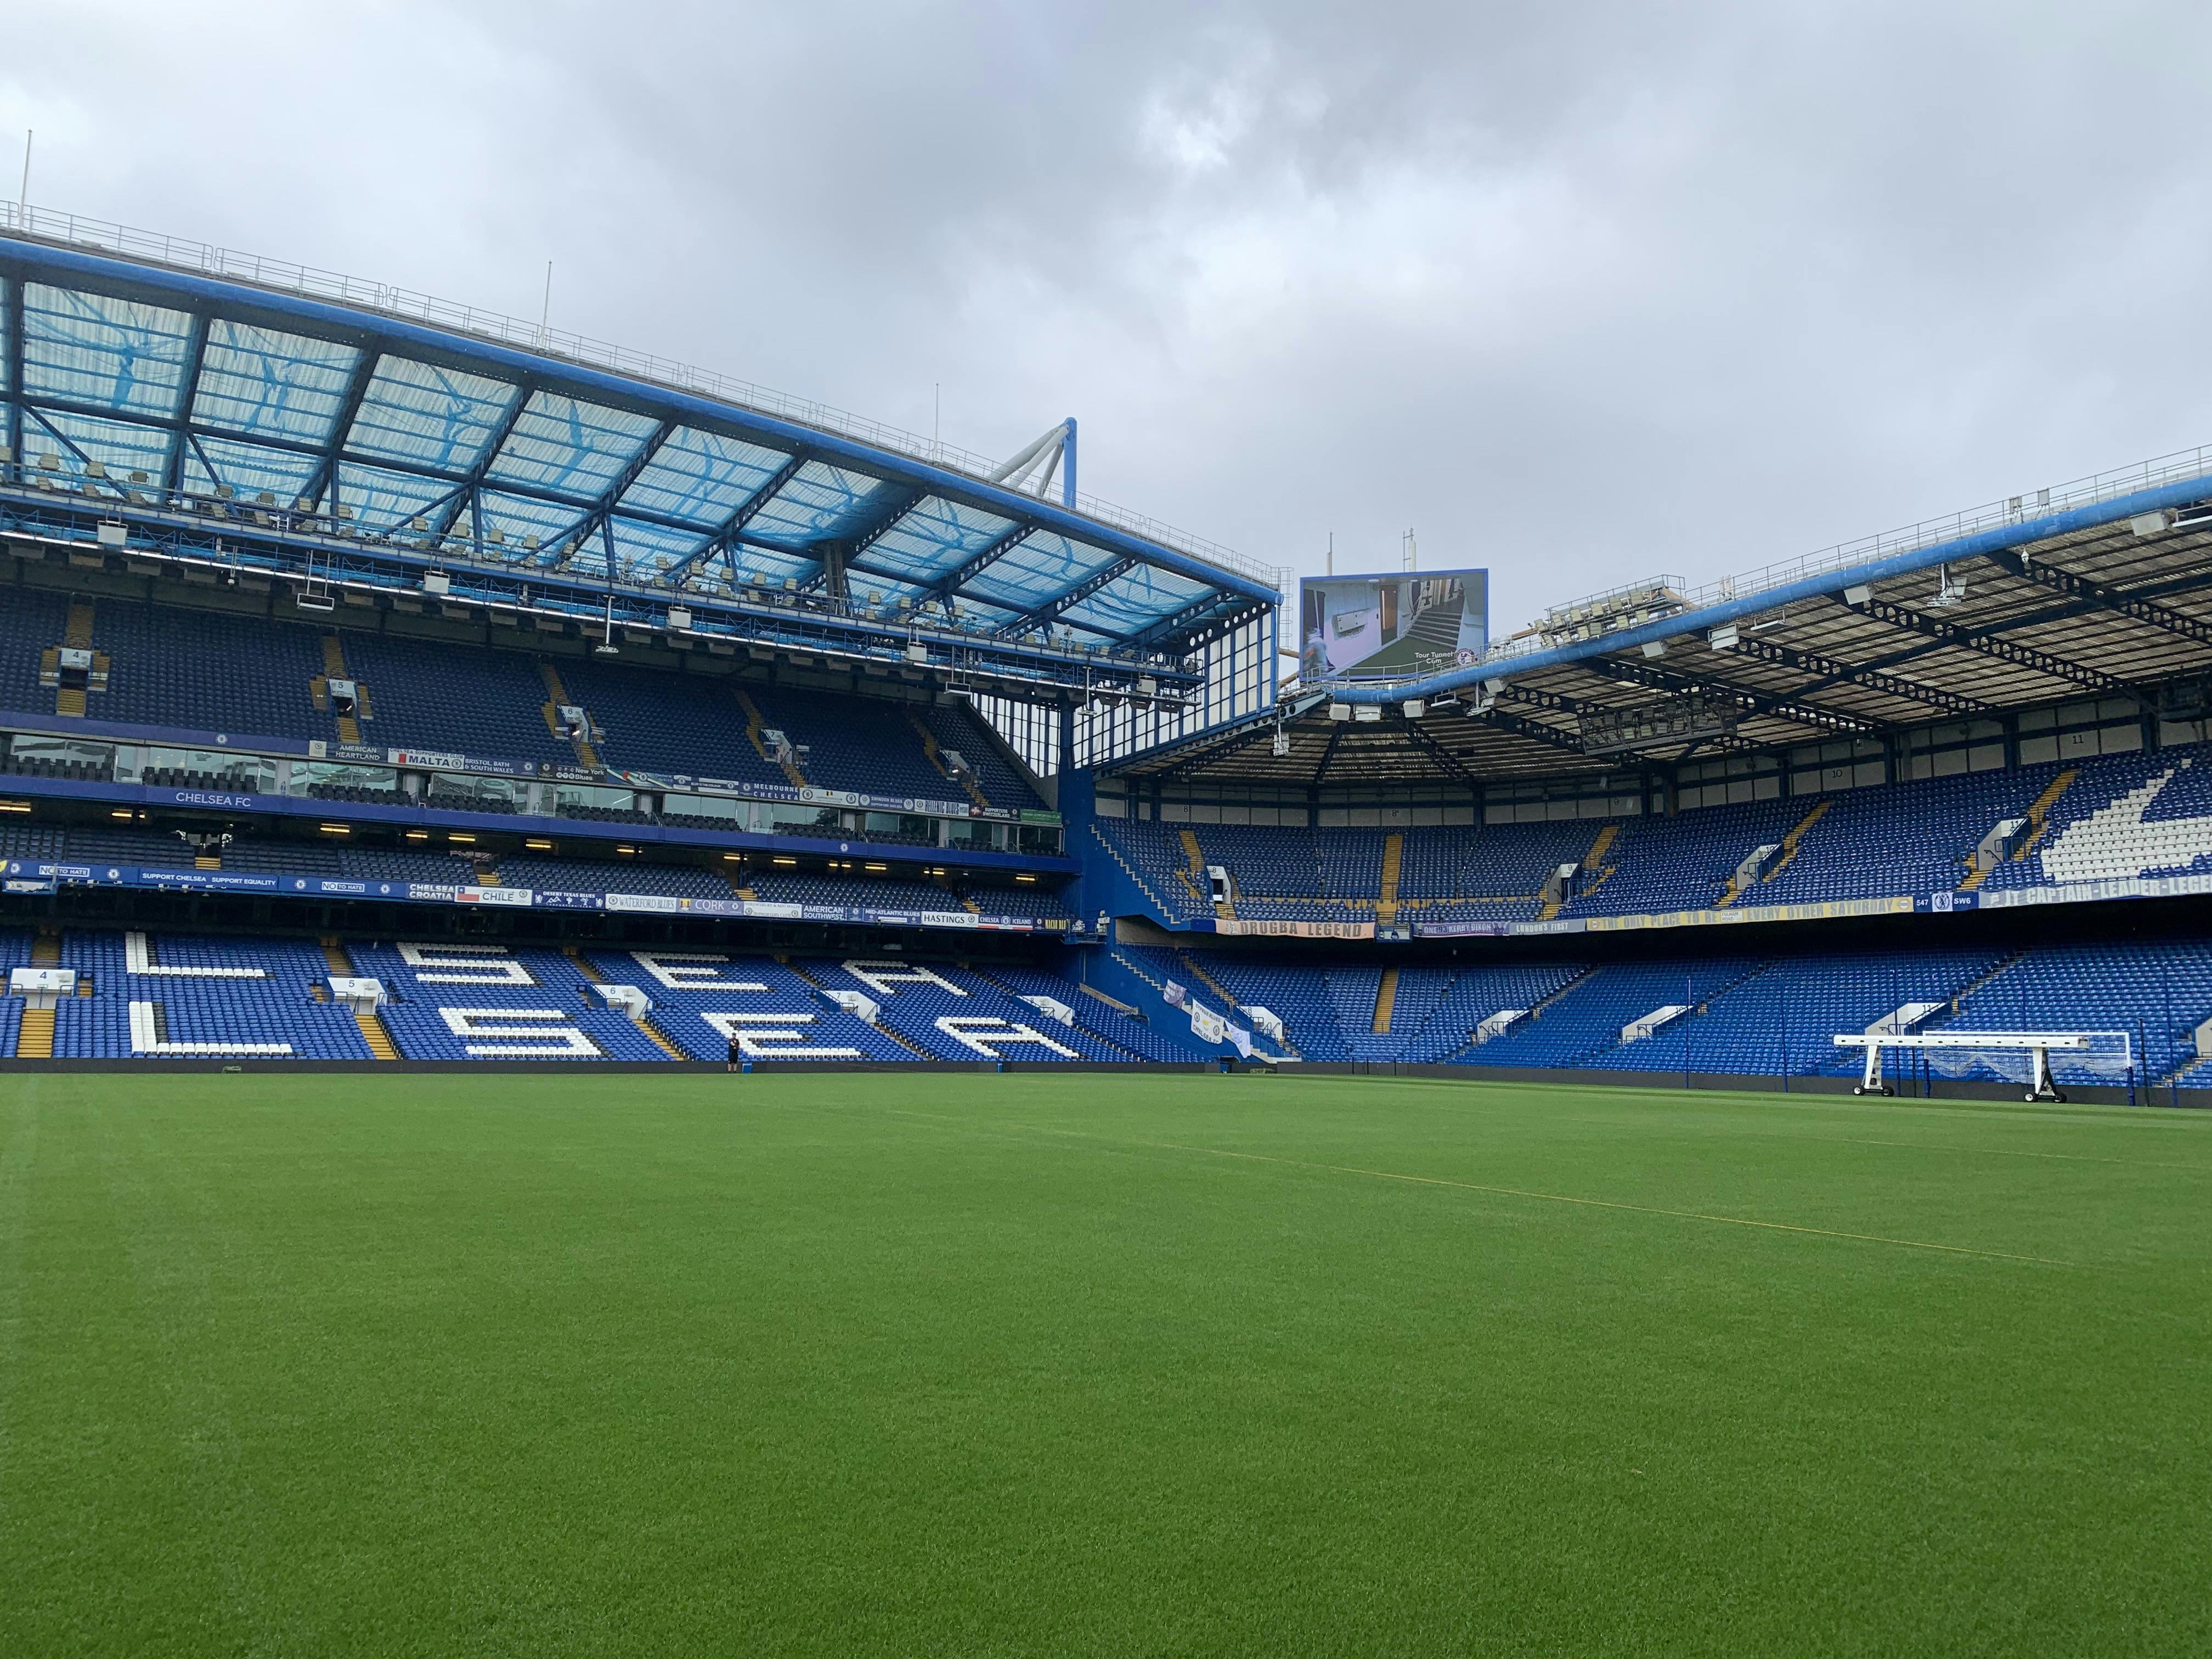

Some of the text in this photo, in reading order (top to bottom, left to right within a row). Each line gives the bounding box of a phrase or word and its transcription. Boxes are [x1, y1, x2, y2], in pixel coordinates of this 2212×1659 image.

[2072, 735, 2084, 744] 11
[340, 745, 377, 753] AMERICAN
[335, 752, 380, 760] HEARTLAND
[409, 755, 450, 766] MALTA
[1832, 769, 1842, 777] 10
[754, 783, 798, 792] MELBOURNE
[176, 792, 251, 807] CHELSEA FC
[754, 791, 799, 800] CHELSEA
[925, 800, 960, 815] HELLENIC BLUES
[2010, 820, 2019, 828] 11
[410, 884, 454, 893] CHELSEA
[2005, 874, 2212, 906] JT CAPTAIN-LEADER-LEGE
[409, 891, 453, 900] CROATIA
[483, 893, 514, 901] CHILE
[619, 896, 674, 910] WATERFORD BLUES
[695, 900, 724, 910] CORK
[804, 905, 843, 914] AMERICAN
[1747, 898, 1893, 920] EVERY OTHER SATURDAY
[924, 915, 965, 924] HASTINGS
[1045, 919, 1058, 929] MACAU
[1058, 919, 1066, 930] BLU
[1602, 911, 1718, 929] THE ONLY PLACE TO BE
[1240, 922, 1362, 937] DROGBA LEGEND
[1448, 924, 1470, 933] KERRY
[1471, 923, 1492, 932] DIXON
[1516, 922, 1569, 933] LONDON'S FIRST
[1195, 1003, 1221, 1023] CYPRUS BLUES
[1193, 1025, 1212, 1042] CHELSEA
